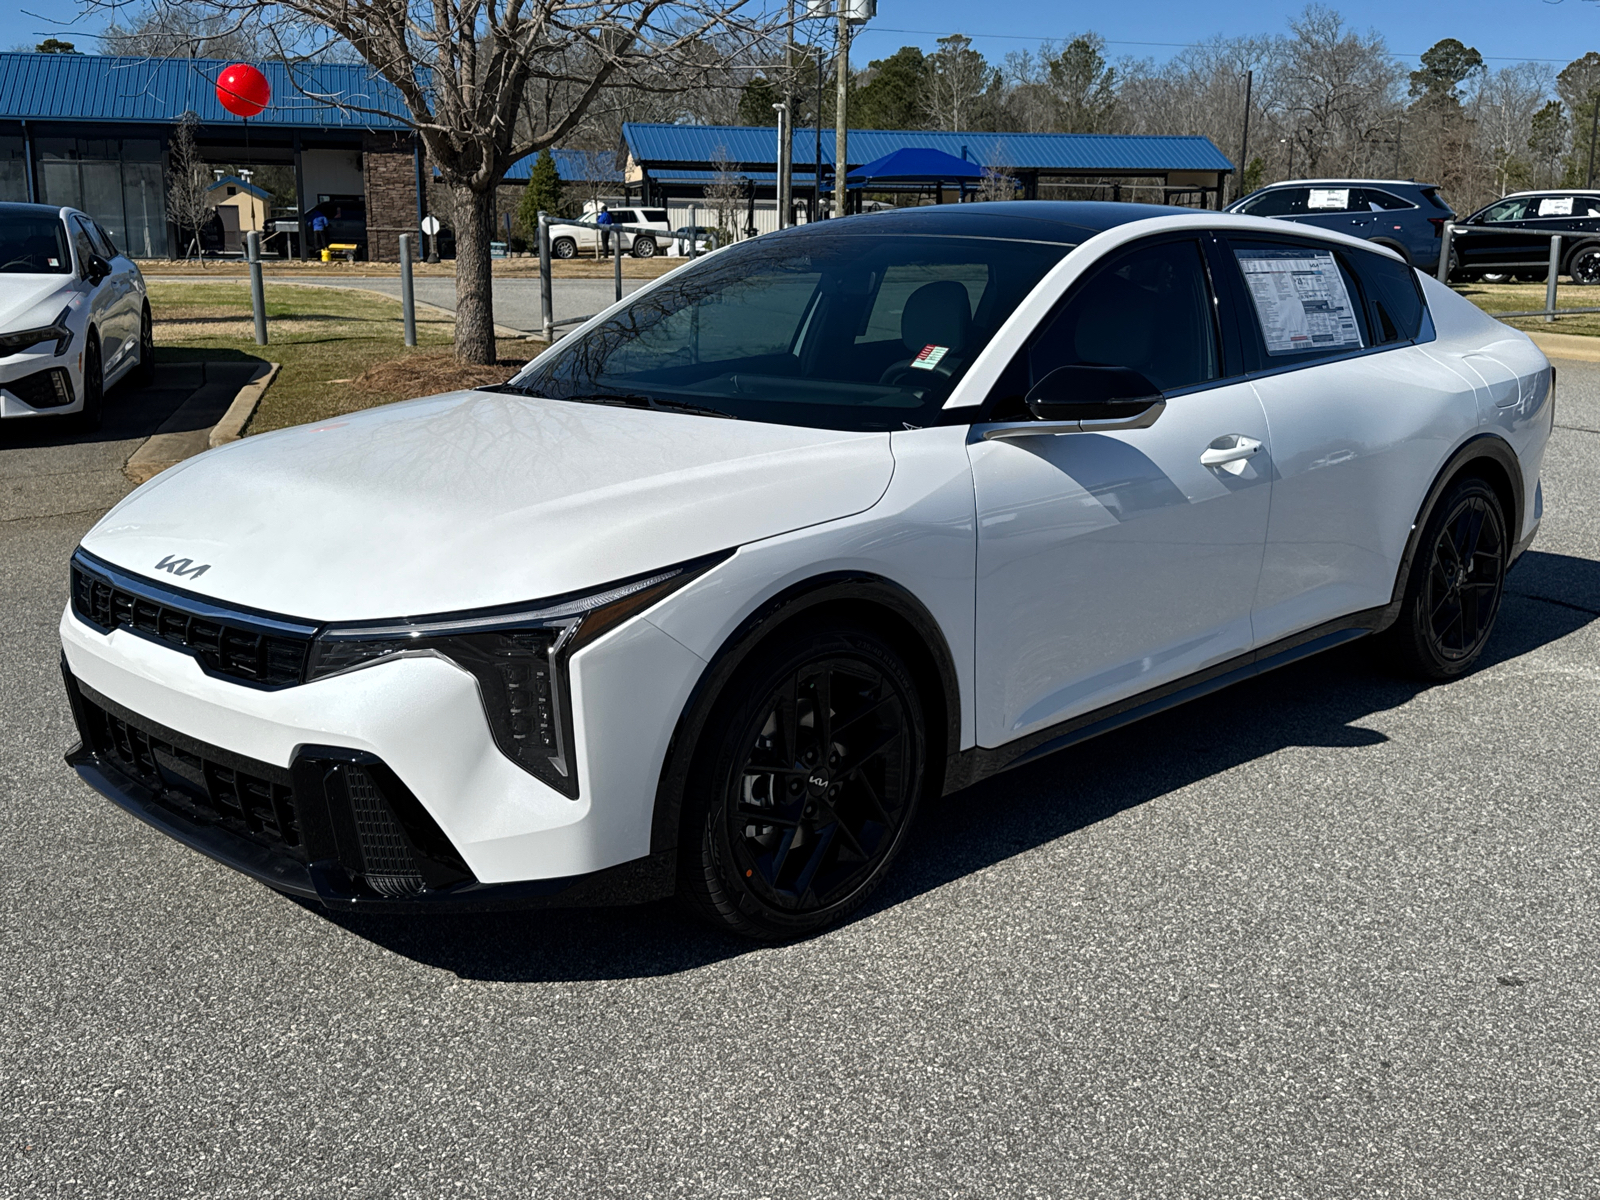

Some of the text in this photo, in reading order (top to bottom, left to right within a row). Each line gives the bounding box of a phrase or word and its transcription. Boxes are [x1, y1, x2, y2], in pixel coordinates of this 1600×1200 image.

[154, 554, 212, 581] KIA
[808, 775, 829, 788] KIA
[832, 872, 883, 921] KUMHO
